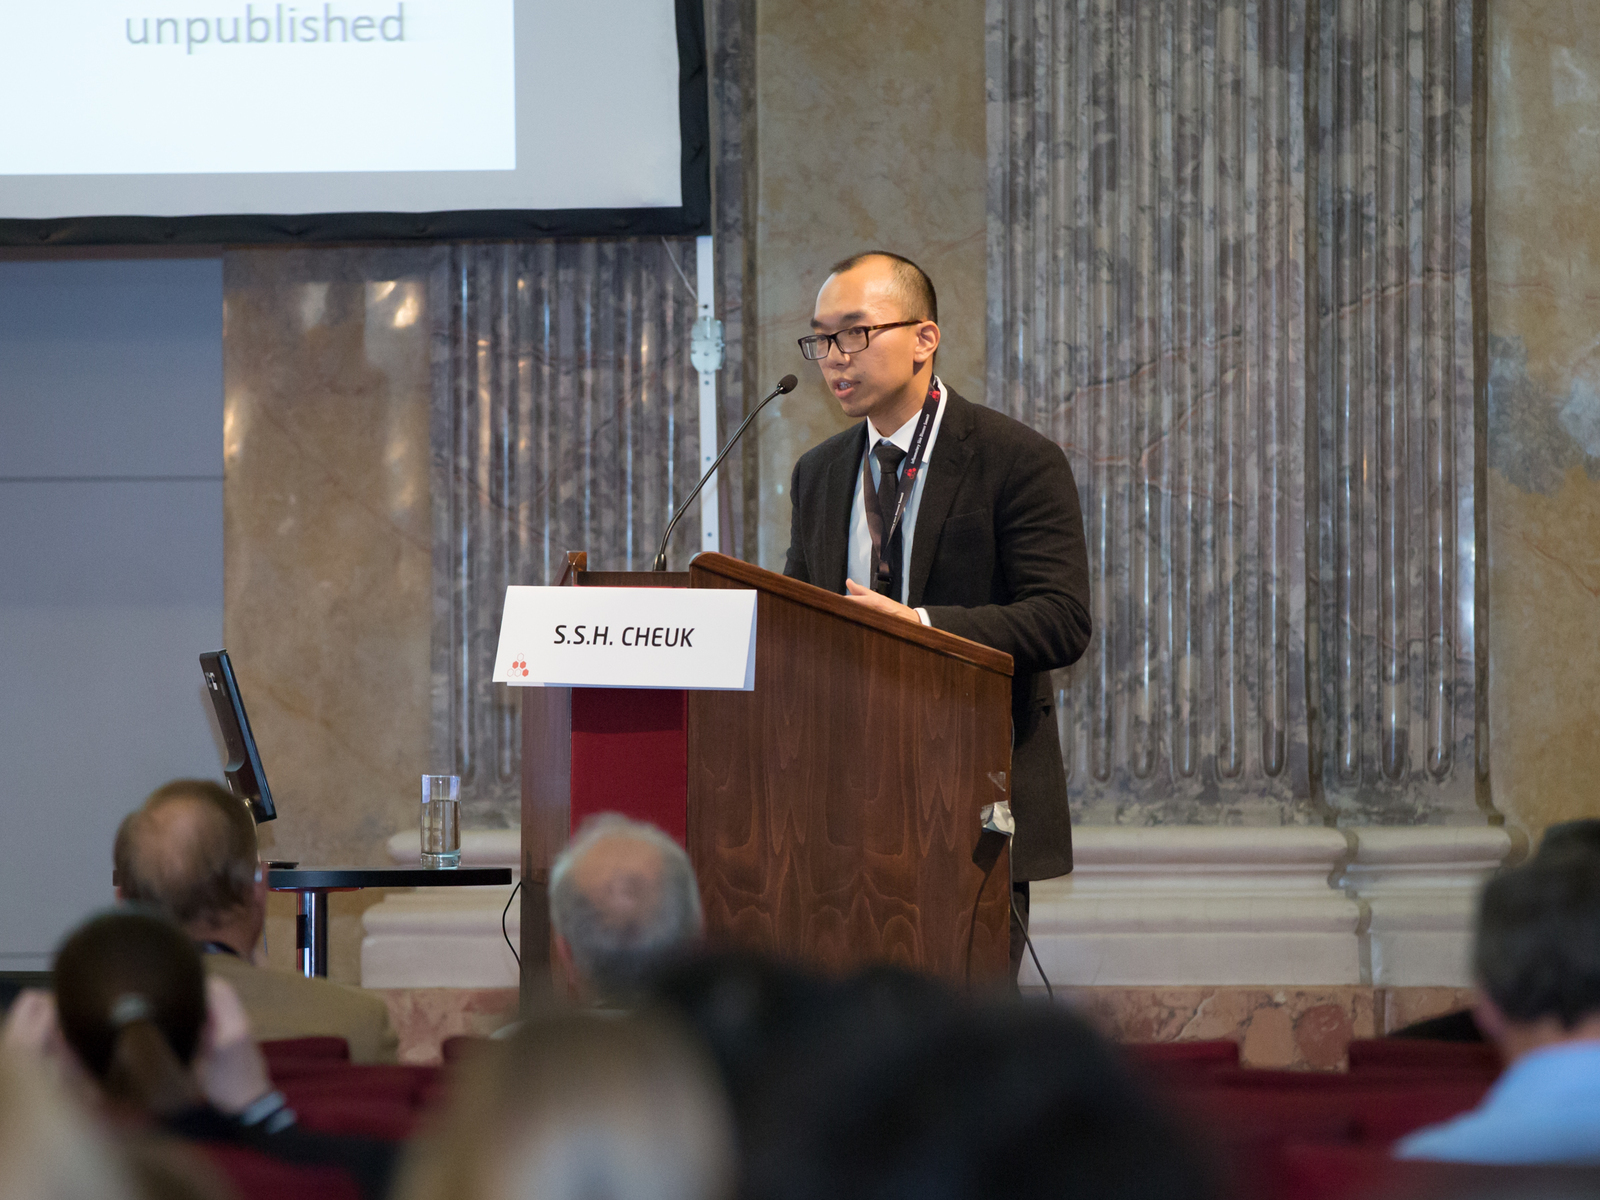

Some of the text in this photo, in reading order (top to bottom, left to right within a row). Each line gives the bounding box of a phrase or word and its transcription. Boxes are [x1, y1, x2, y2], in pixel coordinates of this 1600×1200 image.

[125, 2, 407, 55] unpublished
[553, 624, 695, 648] S.S.H. CHEUK
